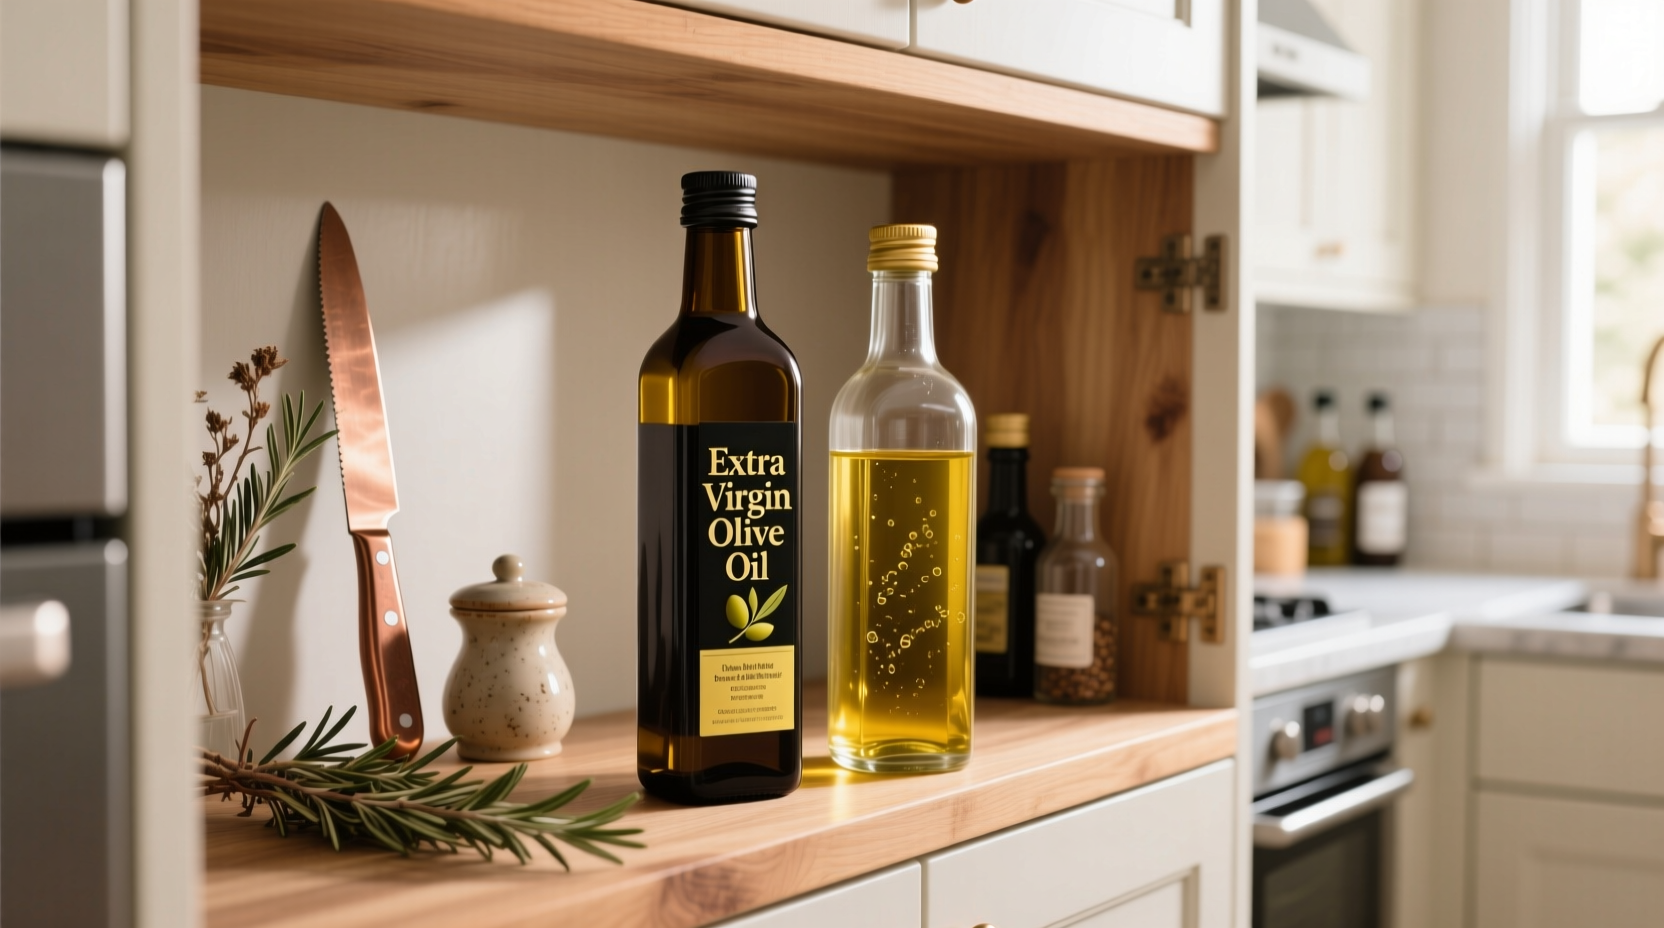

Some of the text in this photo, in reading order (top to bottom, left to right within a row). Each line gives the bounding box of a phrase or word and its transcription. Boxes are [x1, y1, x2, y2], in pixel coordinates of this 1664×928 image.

[708, 447, 786, 476] Extra
[702, 481, 792, 519] Virgin
[708, 517, 785, 547] Olive
[725, 550, 770, 581] Oil
